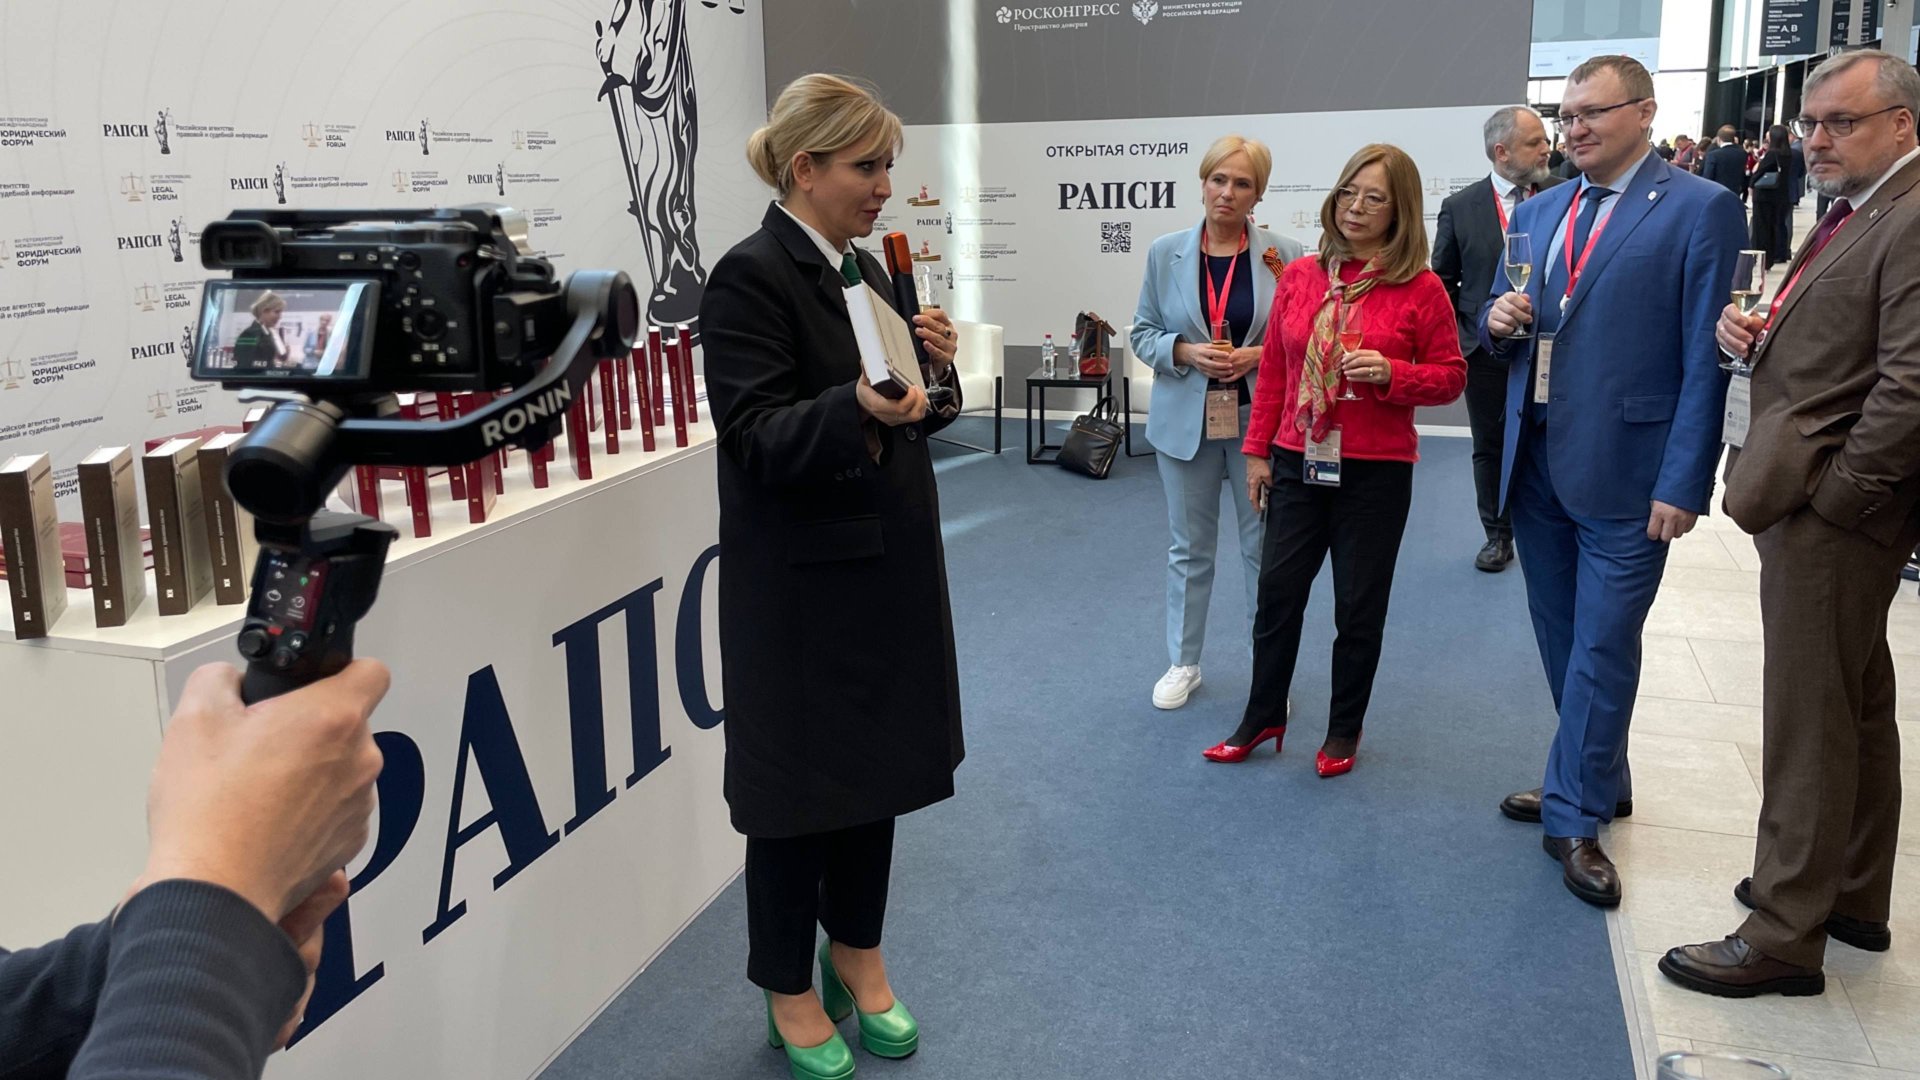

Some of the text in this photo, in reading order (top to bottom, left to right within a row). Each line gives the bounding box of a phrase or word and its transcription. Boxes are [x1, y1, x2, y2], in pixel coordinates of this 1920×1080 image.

[1211, 1, 1243, 9] ЮСТИЦИИ
[1014, 3, 1120, 20] РОСКОНГРЕСС
[1162, 9, 1201, 17] РОССИЙСКОЙ
[1014, 23, 1060, 31] Пространство
[0, 129, 66, 138] ЮРИДИЧЕСКИЙ
[103, 124, 149, 137] РАПСИ
[386, 131, 415, 141] РАПСИ
[1046, 142, 1188, 157] ОТКРЫТАЯ СТУДИЯ
[231, 178, 268, 190] РАПСИ
[468, 174, 493, 184] РАПСИ
[0, 189, 75, 198] удебной информации
[1058, 181, 1176, 210] РАПСИ
[117, 234, 162, 249] РАПСИ
[16, 246, 81, 258] ЮРИДИЧЕСКИЙ
[17, 258, 49, 267] ФОРУМ
[164, 294, 186, 302] LEGAL
[12, 302, 46, 310] агентство
[165, 301, 190, 309] FORUM
[13, 309, 45, 319] судебной
[47, 304, 90, 314] информации
[131, 342, 175, 359] РАПСИ
[32, 360, 96, 377] ЮРИДИЧЕСКИЙ
[33, 374, 64, 385] ФОРУМ
[177, 397, 198, 406] LEGAL
[178, 404, 202, 414] FORUM
[481, 379, 572, 447] RONIN
[0, 416, 60, 433] сийское агентство
[0, 429, 21, 440] вовой
[29, 424, 60, 437] судебной
[61, 415, 104, 429] информации
[54, 487, 78, 498] ОРУМ
[285, 543, 725, 1051] РАПС
